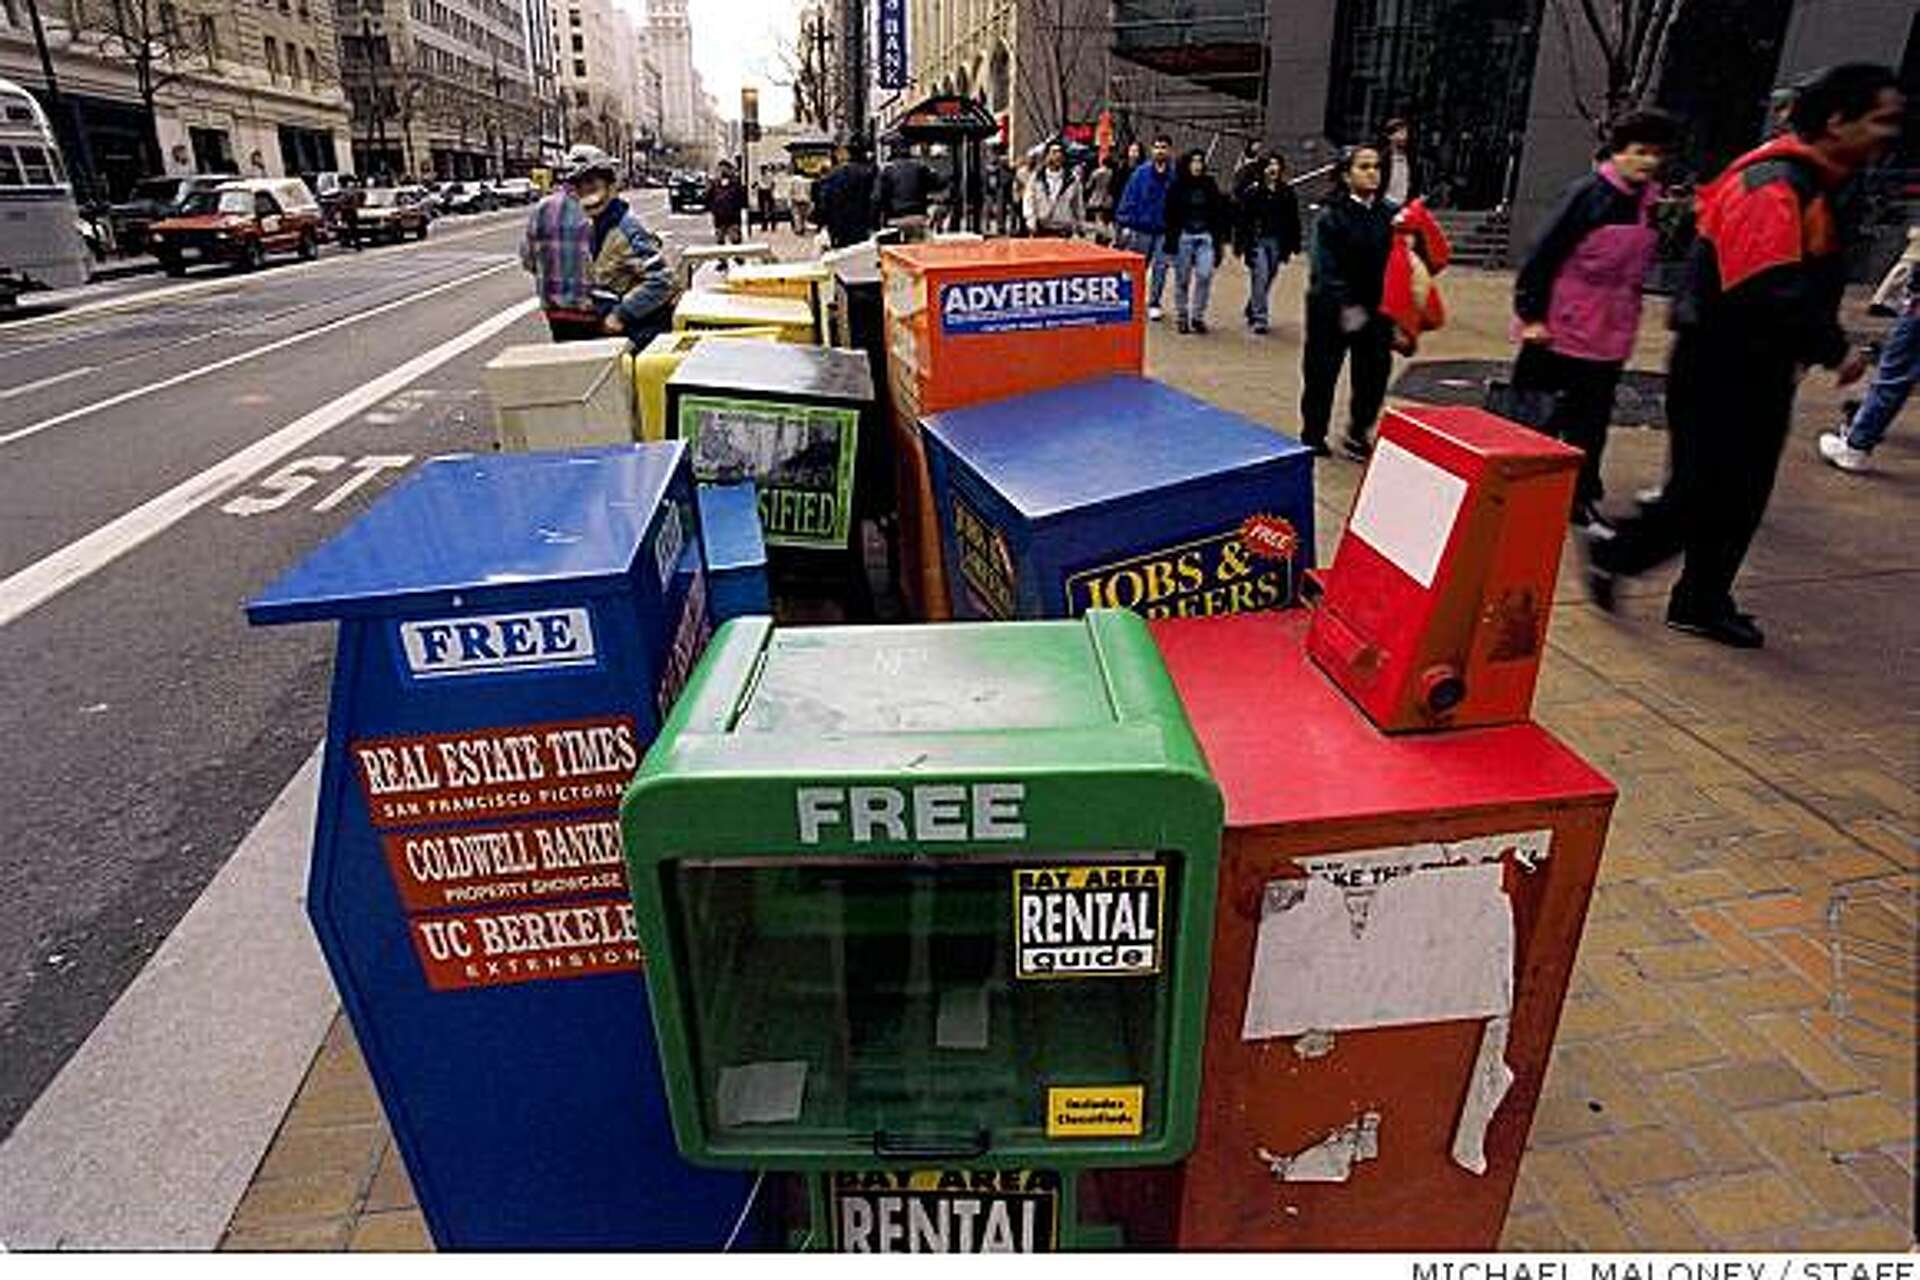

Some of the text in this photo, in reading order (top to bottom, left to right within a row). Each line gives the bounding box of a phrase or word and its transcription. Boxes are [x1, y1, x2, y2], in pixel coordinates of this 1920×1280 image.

[944, 276, 1120, 315] ADVERTISER
[1250, 523, 1290, 550] FREE
[1087, 542, 1252, 609] JOBS &
[418, 612, 578, 666] FREE
[358, 725, 637, 794] REAL ESTATE TIMES
[384, 781, 628, 818] SAN FRANCISCO PICTORIA
[797, 783, 1027, 844] FREE
[405, 829, 537, 882] COLDWELL
[446, 873, 624, 903] PROPERTY SHOWCASE
[1086, 868, 1160, 888] AREA
[1022, 891, 1156, 943] RENTAL
[420, 918, 472, 960] UC
[464, 948, 646, 978] EXTENSION
[1032, 945, 1143, 973] guide
[837, 1169, 1059, 1190] BAY AREA
